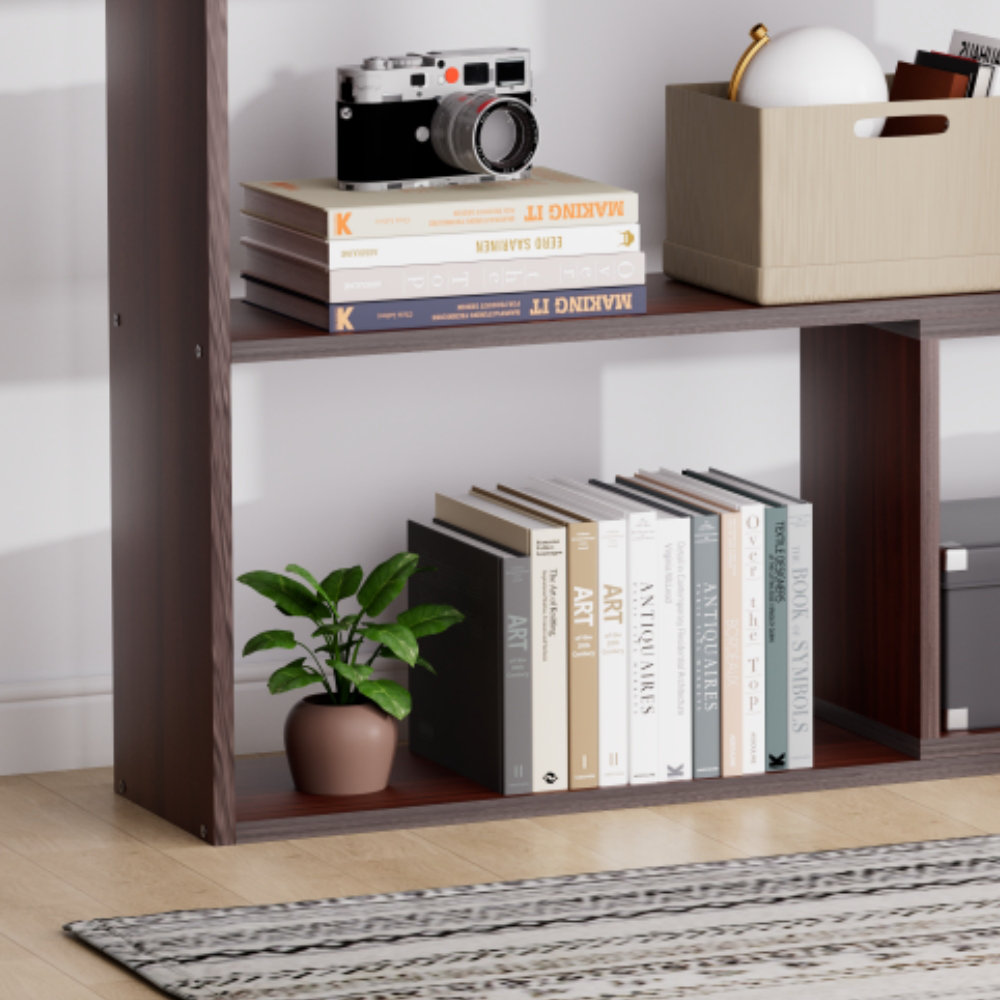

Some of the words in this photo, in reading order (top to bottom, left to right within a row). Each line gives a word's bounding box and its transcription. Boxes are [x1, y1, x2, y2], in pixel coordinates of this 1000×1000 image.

[334, 211, 353, 237] K
[524, 205, 544, 222] IT
[548, 201, 625, 221] MAKING
[475, 238, 532, 254] SAARINEN
[534, 236, 563, 251] EERO
[529, 297, 551, 316] IT
[554, 292, 633, 314] MAKING
[335, 305, 356, 332] K
[573, 585, 595, 627] ART
[603, 583, 624, 625] ART
[791, 567, 810, 622] BOOK
[507, 614, 528, 651] ART
[637, 582, 656, 715] ANTIQUAIRES
[701, 582, 719, 713] ANTIQUAIRES
[790, 640, 810, 734] SYMBOLS
